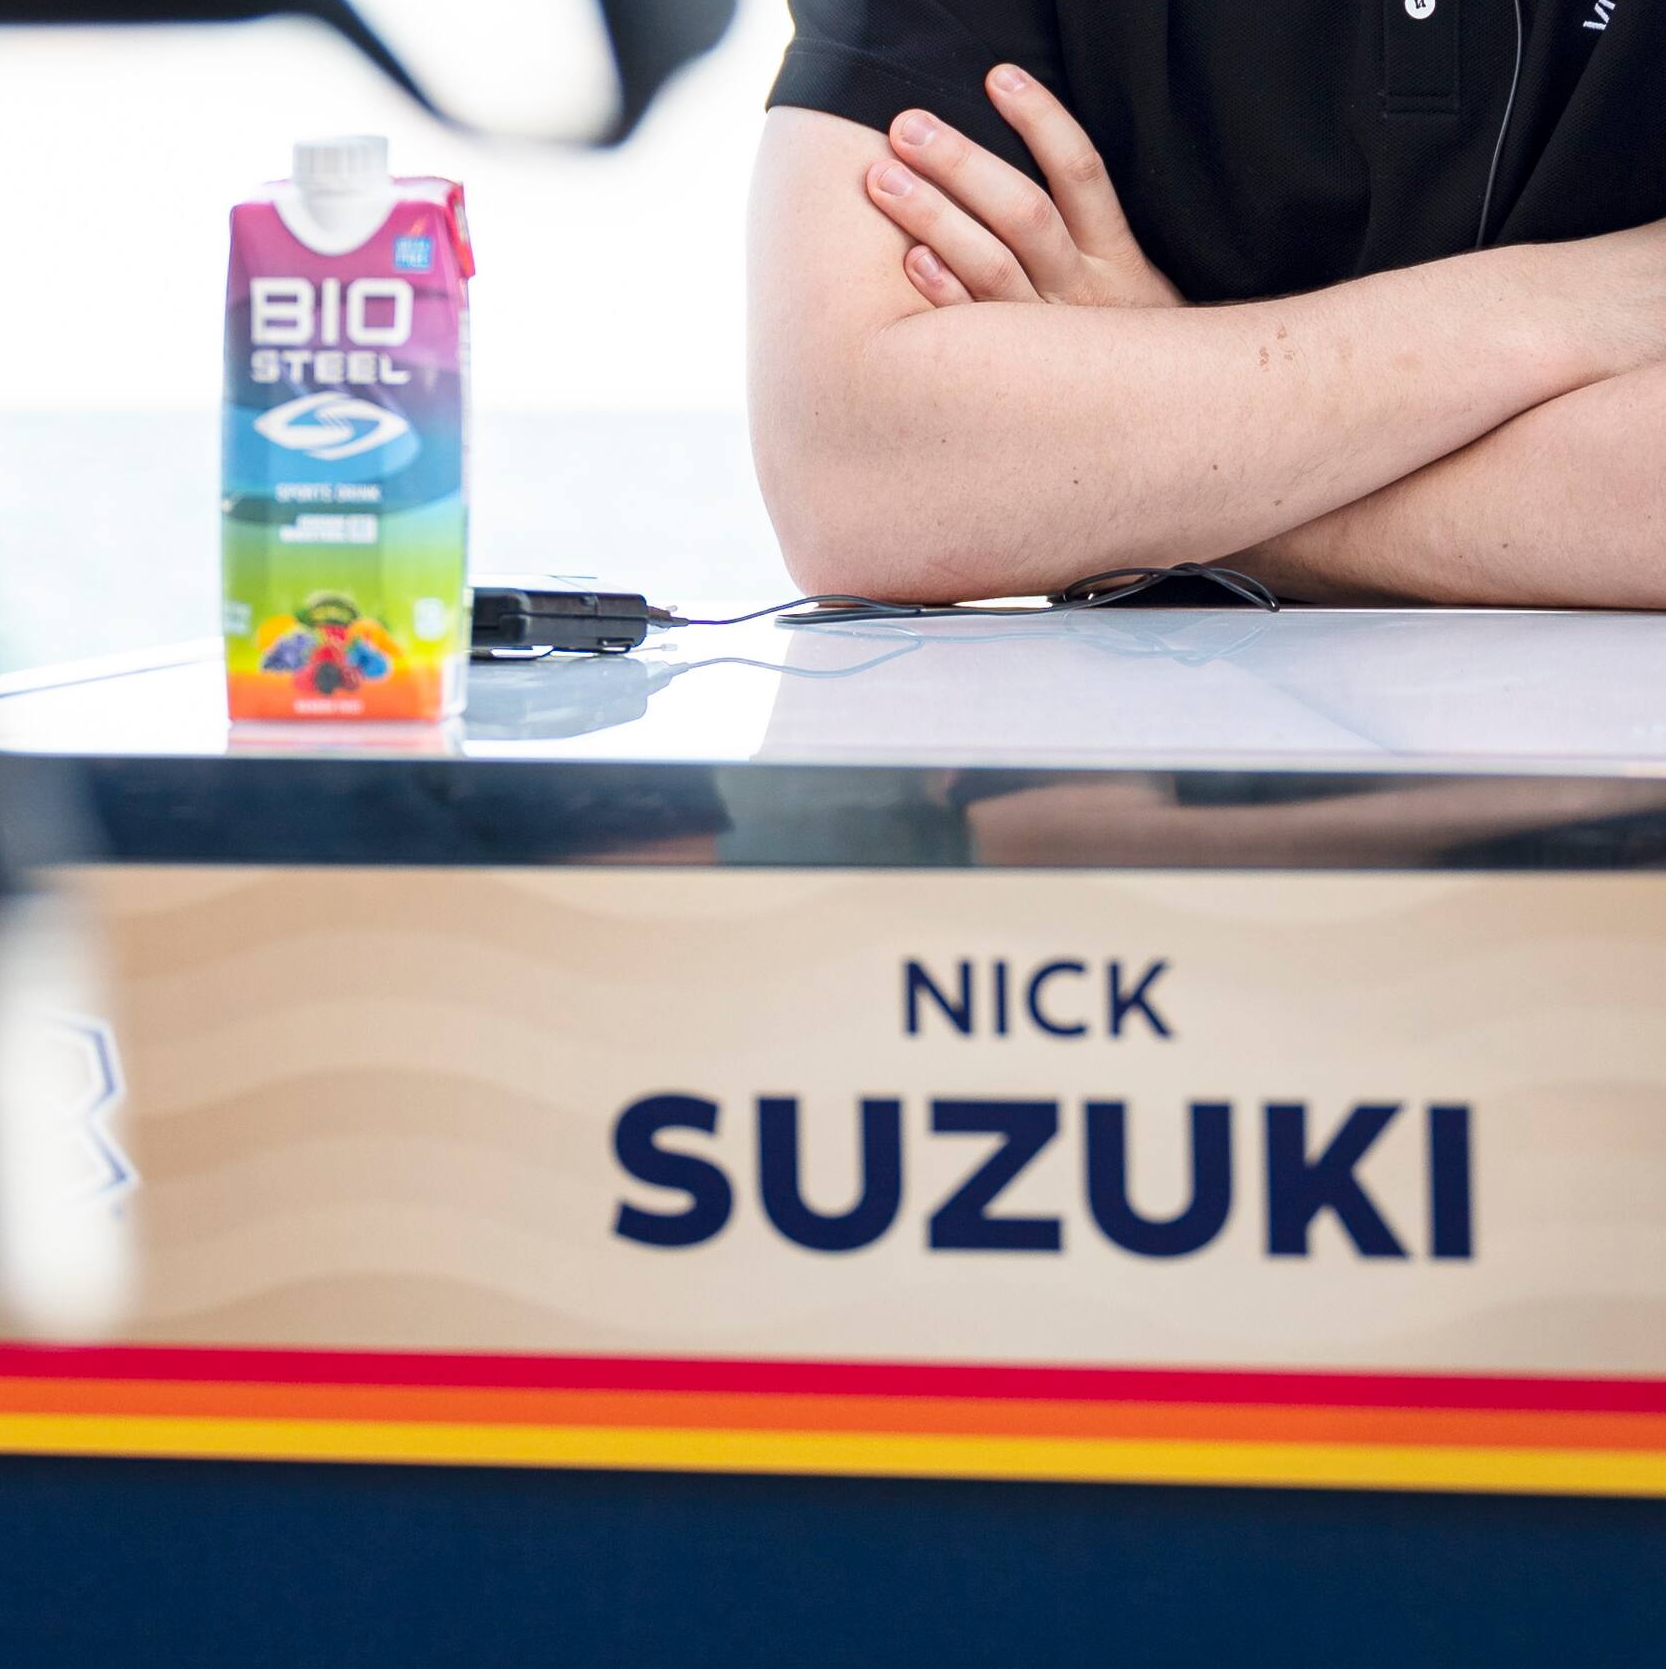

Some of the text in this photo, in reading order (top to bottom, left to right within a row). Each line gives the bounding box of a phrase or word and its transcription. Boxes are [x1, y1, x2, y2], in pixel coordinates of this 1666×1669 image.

[250, 277, 414, 347] BIO
[250, 350, 411, 385] STEEL
[902, 959, 1173, 1039] NICK
[610, 1091, 1476, 1262] SUZUKI
